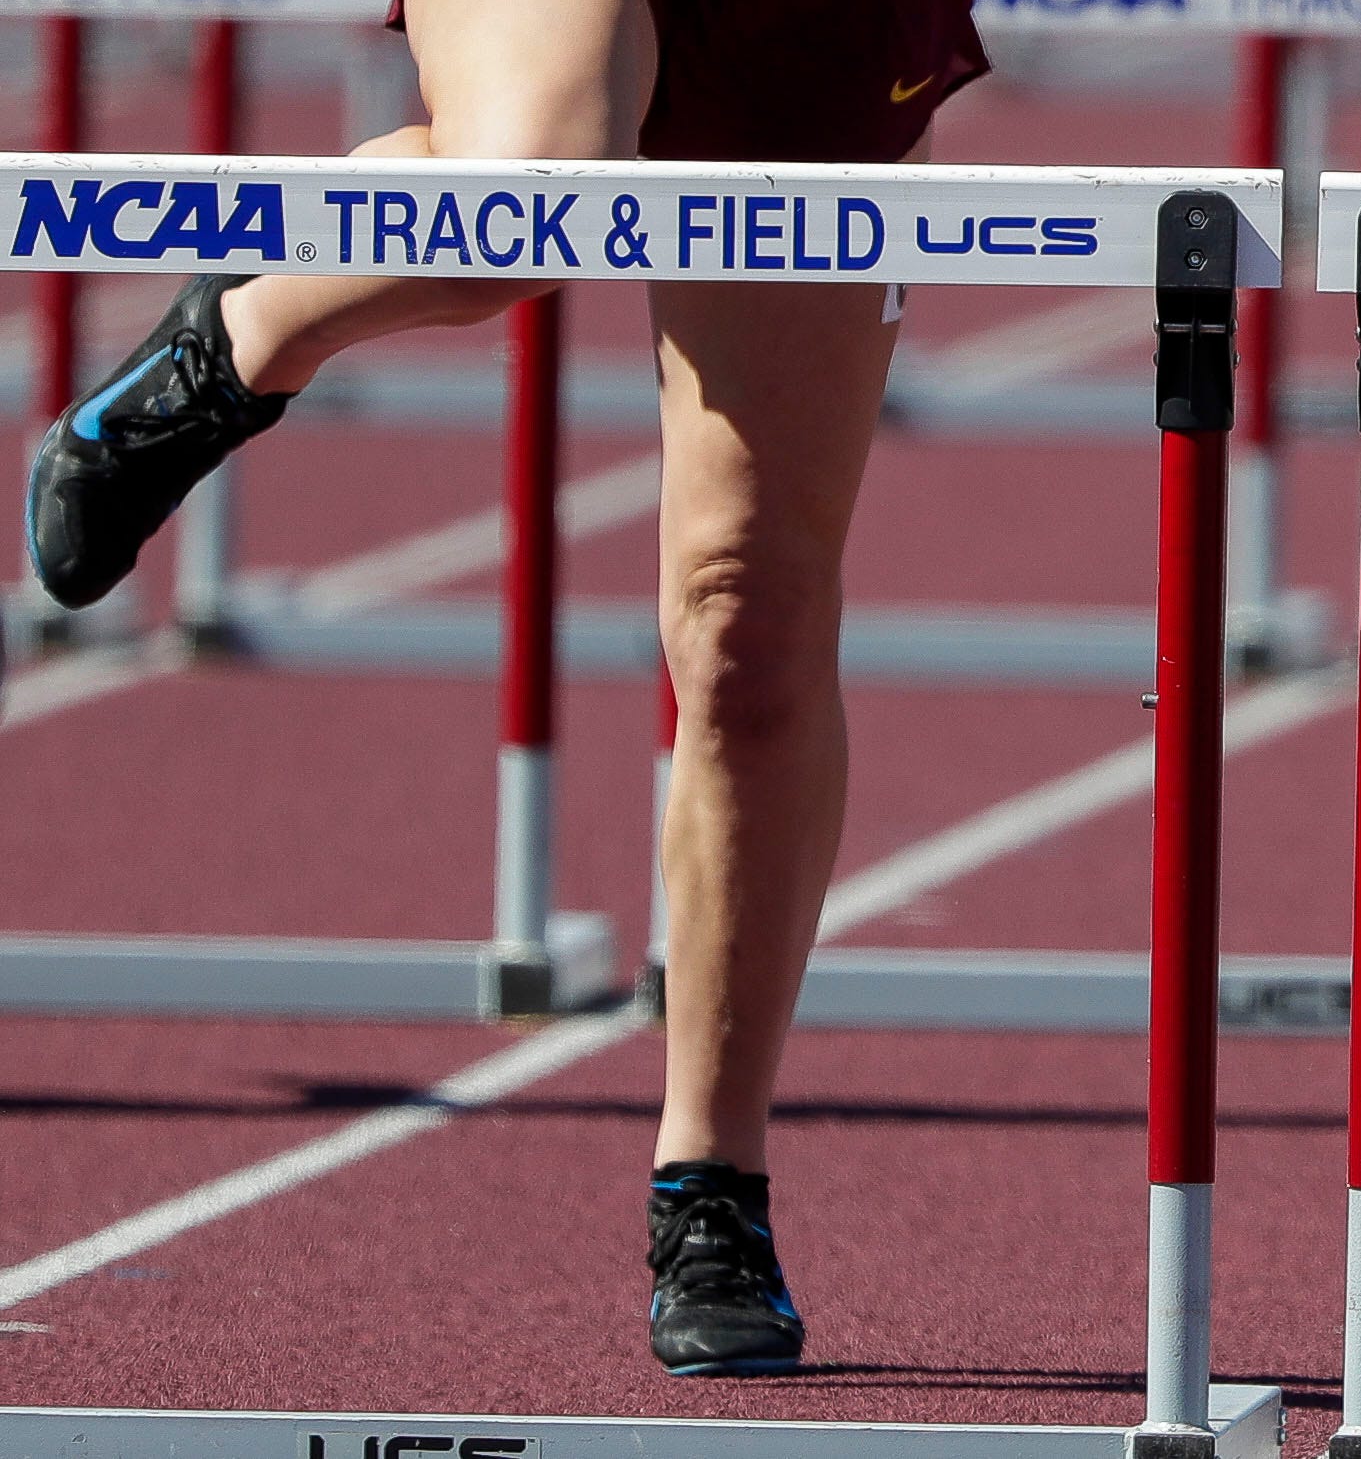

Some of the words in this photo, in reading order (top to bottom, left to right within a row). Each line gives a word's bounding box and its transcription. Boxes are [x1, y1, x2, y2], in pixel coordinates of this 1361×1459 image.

[12, 179, 287, 261] NCAA
[324, 190, 580, 267] TRACK
[605, 194, 651, 269] &
[678, 195, 885, 271] FIELD
[917, 216, 1099, 256] UCS
